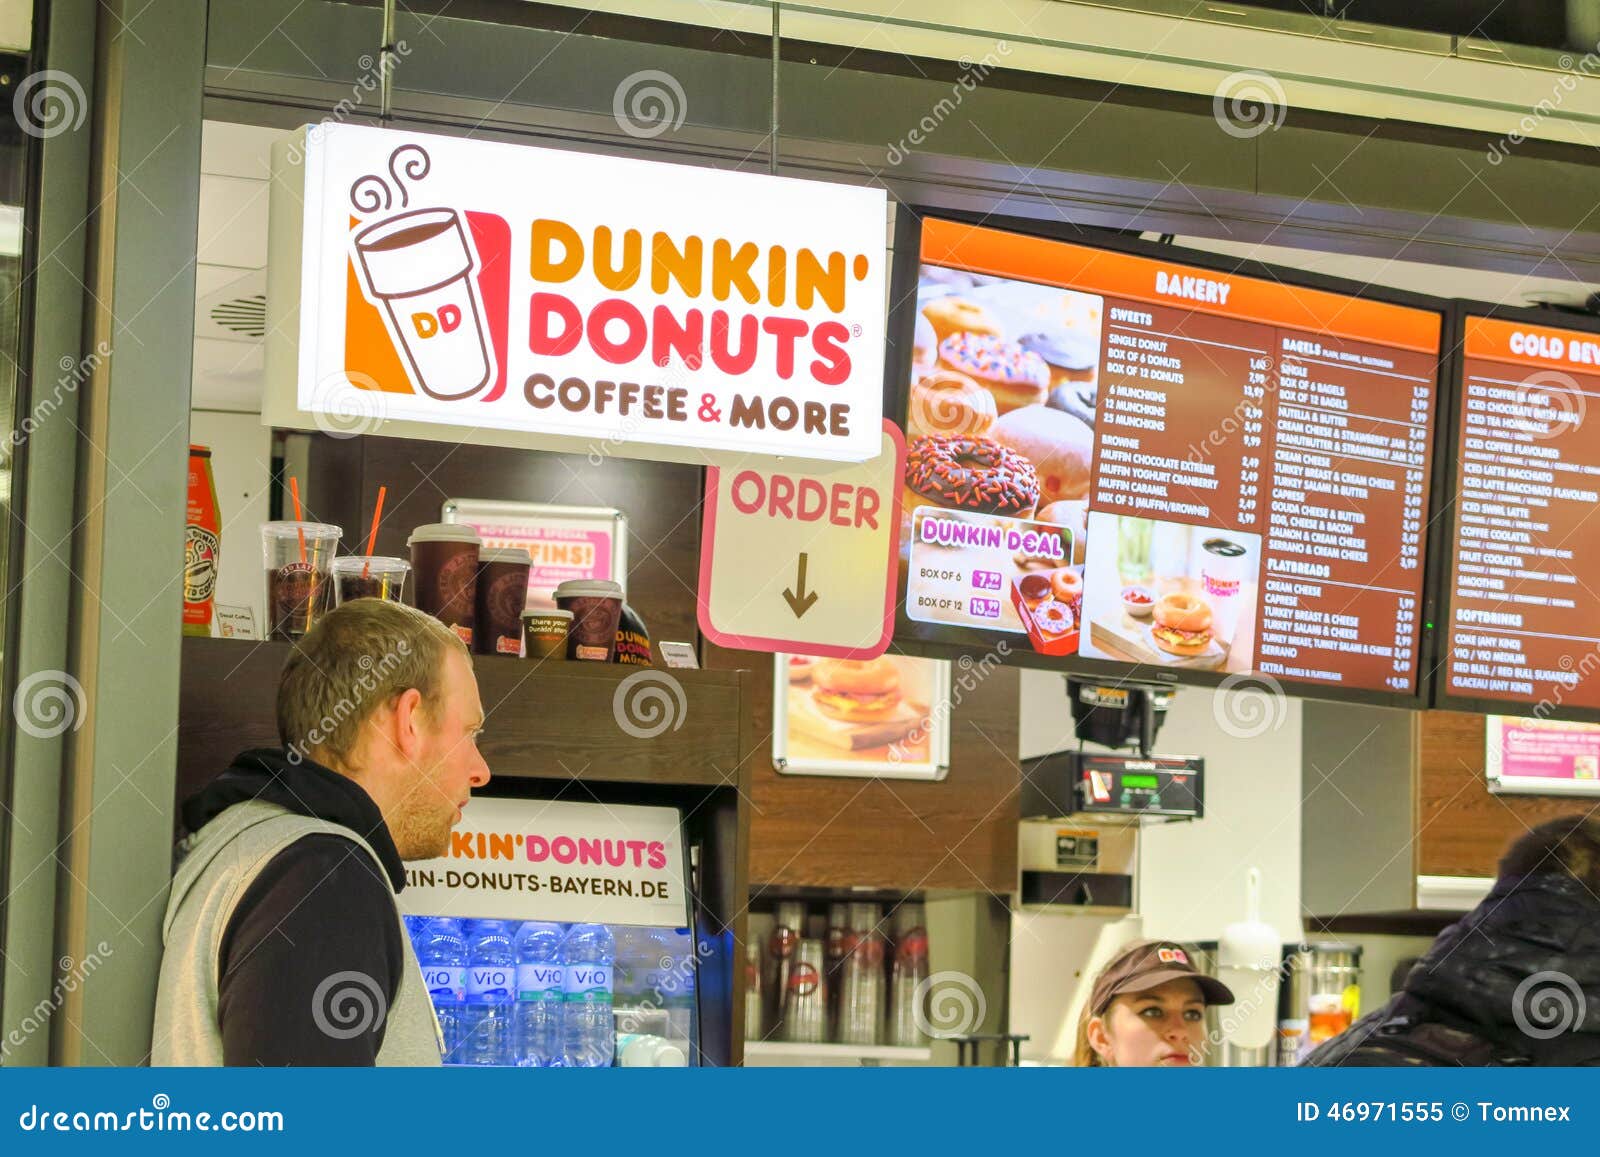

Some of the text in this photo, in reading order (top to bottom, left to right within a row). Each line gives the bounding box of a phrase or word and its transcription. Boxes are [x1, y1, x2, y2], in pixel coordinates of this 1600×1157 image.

[530, 218, 869, 313] DUNKIN'
[1155, 272, 1231, 305] BAKERY
[411, 304, 462, 339] DD
[1111, 308, 1152, 326] SWEETS
[528, 291, 852, 386] DONUTS
[1109, 334, 1167, 352] SINGLE DONUT
[1283, 339, 1325, 356] BAGELS
[1510, 333, 1565, 360] COLD
[1108, 348, 1126, 360] BOX
[1127, 351, 1138, 362] OF
[1140, 353, 1146, 364] 6
[1147, 354, 1181, 370] DONUTS
[1107, 362, 1125, 374] BOX
[1126, 365, 1138, 377] OF
[1140, 367, 1149, 378] 12
[1150, 369, 1184, 384] DONUTS
[523, 373, 851, 438] COFFEE & MORE
[1102, 434, 1139, 450] BROWNIE
[1101, 449, 1132, 463] MUFFIN
[1133, 454, 1179, 470] CHOCOLATE
[1180, 460, 1215, 475] EXTREME
[1099, 477, 1130, 491] MUFFIN
[1131, 482, 1168, 497] CARAMEL
[1100, 463, 1131, 477] MUFFIN
[1132, 468, 1171, 483] YOGHURT
[1172, 474, 1218, 490] CRANBERRY
[731, 470, 880, 530] ORDER
[922, 519, 1001, 549] DUNKIN
[920, 568, 939, 579] BOX
[941, 570, 954, 581] OF
[955, 572, 962, 582] 6
[1268, 559, 1330, 578] FLATBREADS
[918, 597, 937, 607] BOX
[938, 599, 952, 609] OF
[954, 600, 962, 611] 12
[531, 618, 551, 626] Share
[440, 831, 524, 860] KIN'
